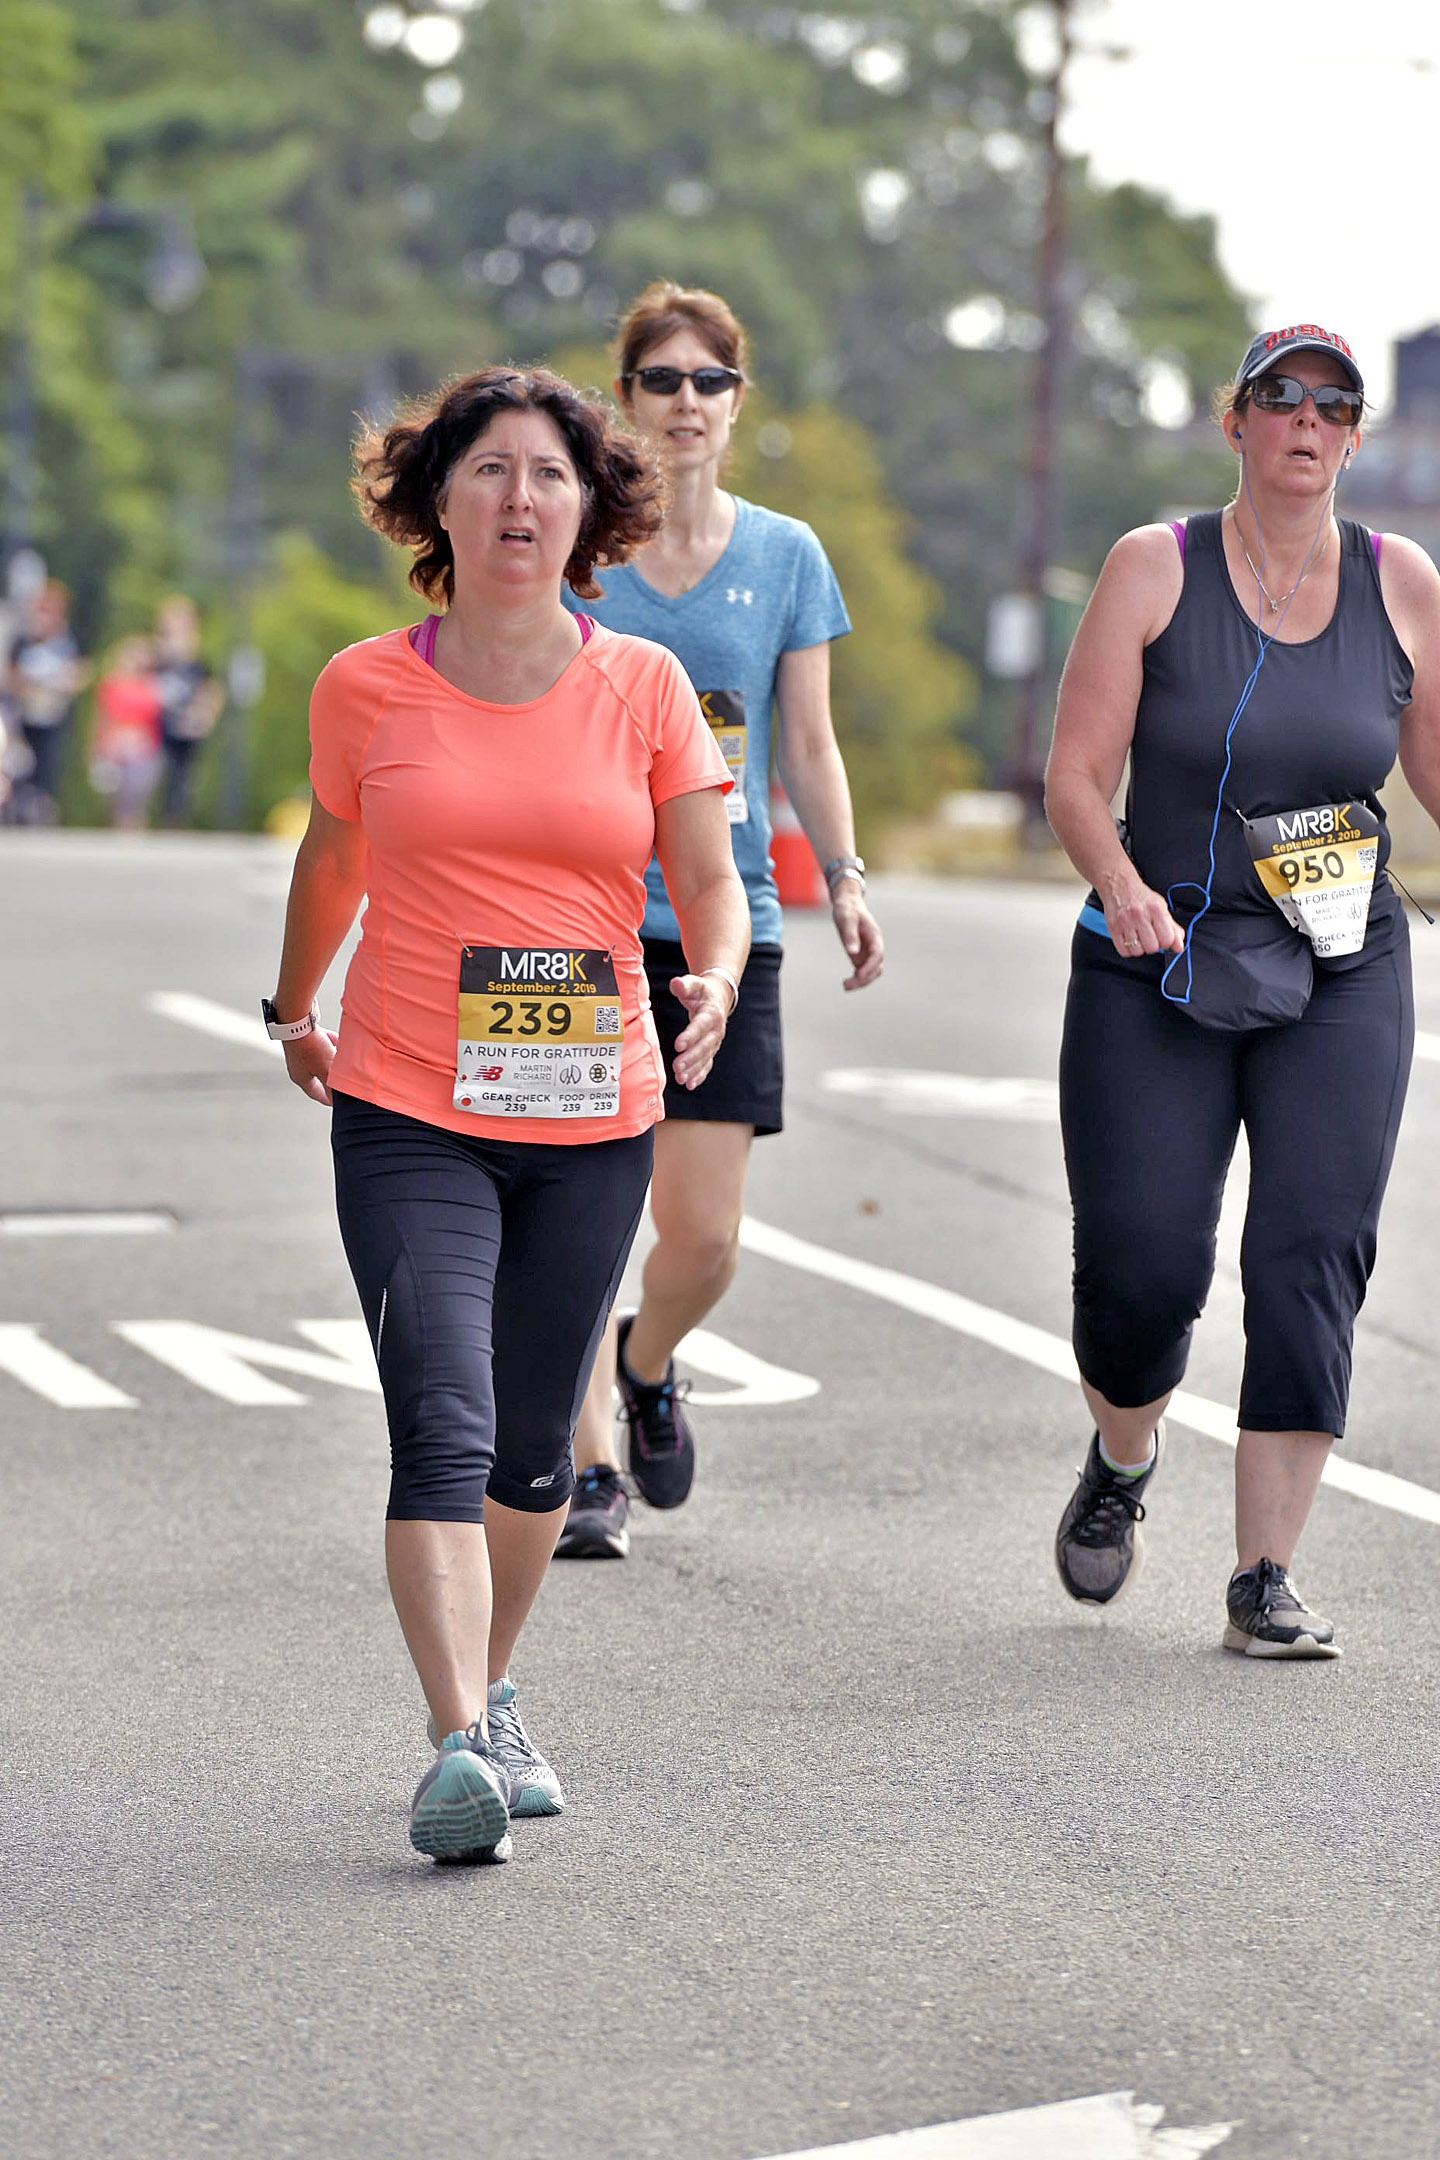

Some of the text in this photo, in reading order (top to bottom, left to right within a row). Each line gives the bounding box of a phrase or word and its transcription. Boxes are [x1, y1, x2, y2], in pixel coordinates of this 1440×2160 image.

[1264, 324, 1352, 358] DUBLIN
[1276, 804, 1352, 841] MR8K
[1272, 829, 1361, 854] September 2, 2019
[1278, 851, 1345, 888] 950
[1305, 893, 1328, 904] FOR
[500, 951, 587, 980] MR8K
[487, 981, 597, 994] September 2, 2019
[488, 1001, 572, 1035] 239
[463, 1045, 617, 1059] A RUN FOR GRATITUDE
[513, 1073, 552, 1081] RICHARD
[482, 1092, 551, 1102] GEAR CHECK
[590, 1092, 618, 1100] DRINK
[504, 1103, 527, 1112] 239
[562, 1103, 581, 1112] 239
[594, 1102, 613, 1110] 239
